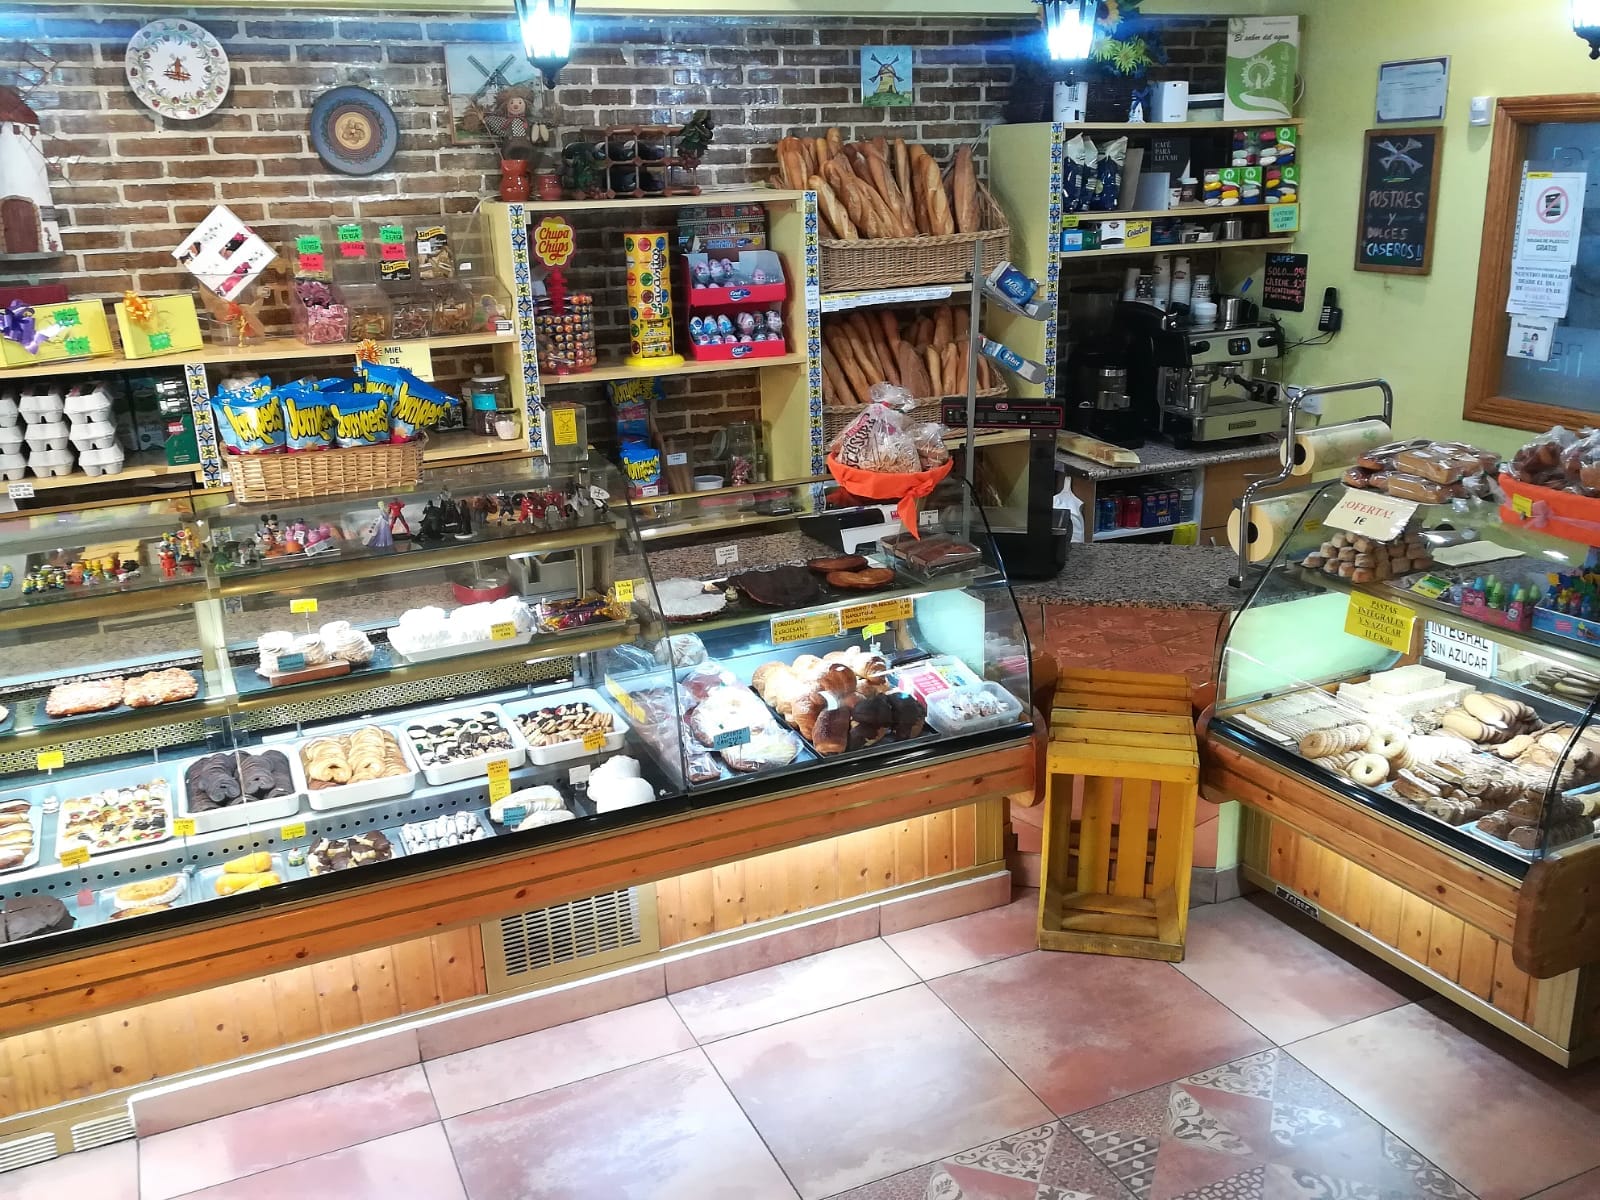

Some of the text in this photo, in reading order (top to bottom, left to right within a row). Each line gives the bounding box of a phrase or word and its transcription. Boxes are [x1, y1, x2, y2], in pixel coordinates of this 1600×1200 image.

[1369, 190, 1424, 209] POSTRES
[539, 227, 570, 242] Chupa
[1367, 226, 1409, 240] DULCES
[538, 240, 569, 255] Chups
[1536, 244, 1558, 252] GRATIS
[650, 247, 664, 315] Lacasitos
[1004, 277, 1028, 298] HALLS
[384, 346, 403, 355] MIEL
[330, 399, 389, 443] Jumpers
[1358, 606, 1404, 627] INTEGRALES
[1371, 600, 1398, 615] PASTAS
[1431, 621, 1489, 650] INTEGRAL
[1431, 640, 1488, 671] SIN AZUCAR
